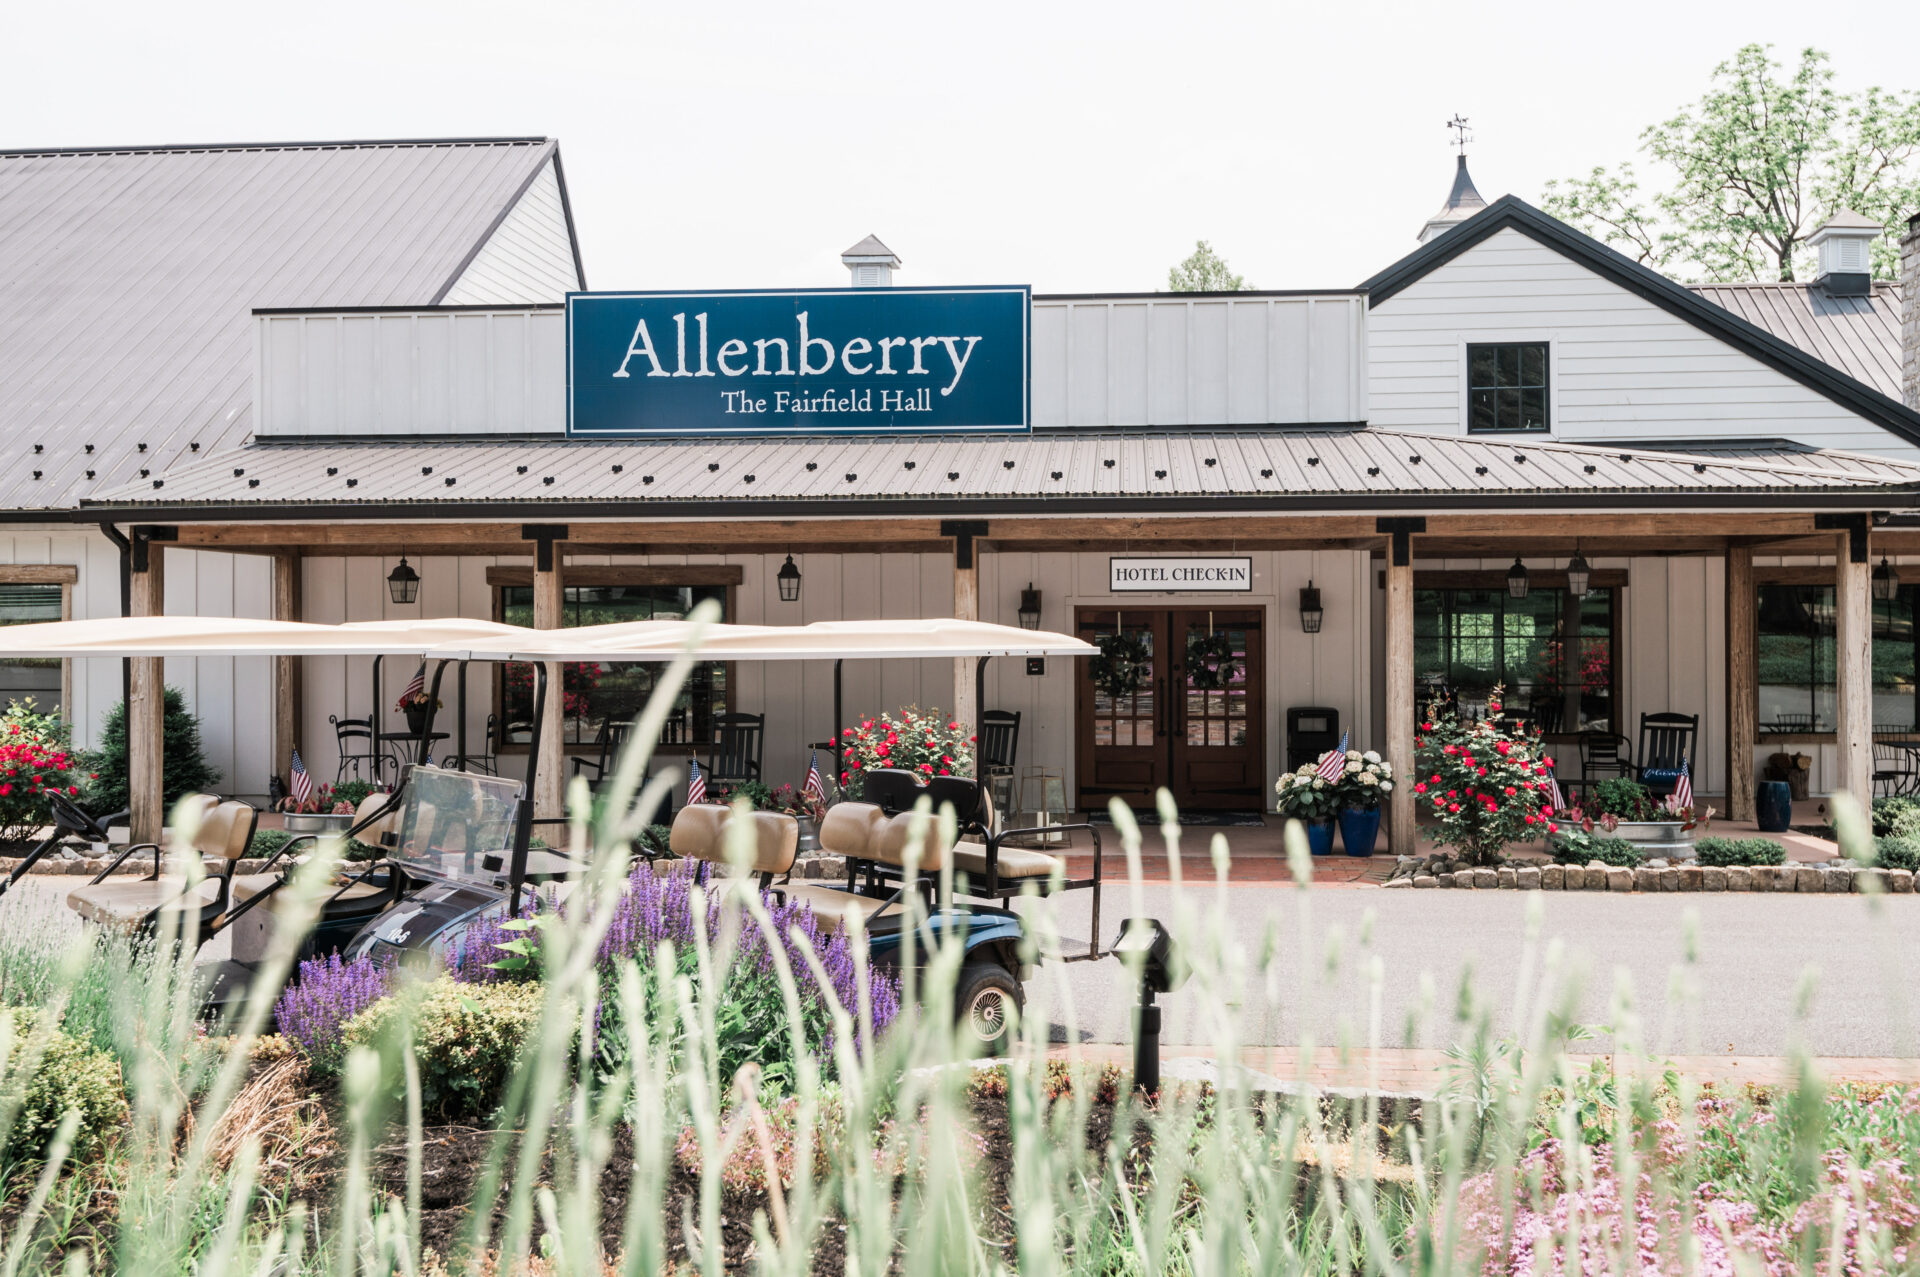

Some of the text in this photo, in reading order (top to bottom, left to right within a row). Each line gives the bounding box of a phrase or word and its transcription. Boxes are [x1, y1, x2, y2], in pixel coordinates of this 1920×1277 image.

[612, 311, 983, 397] Allenberry
[721, 388, 933, 414] The Fairfield Hall
[1116, 567, 1246, 581] HOTEL CHECK-IN
